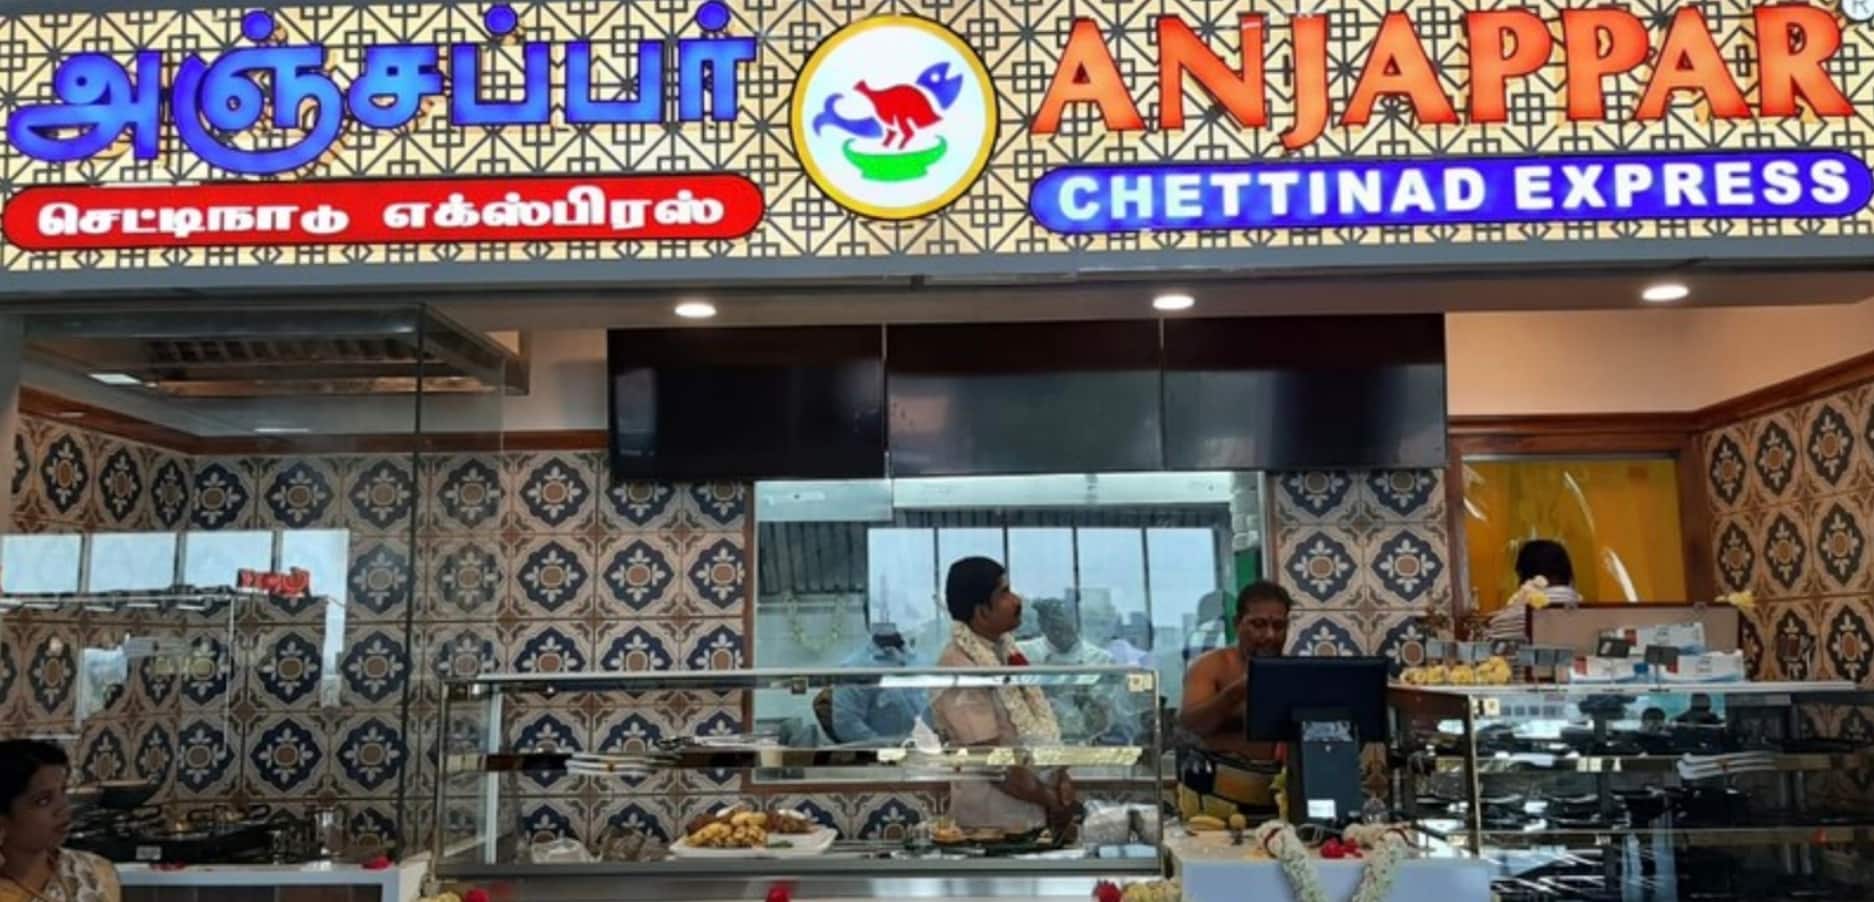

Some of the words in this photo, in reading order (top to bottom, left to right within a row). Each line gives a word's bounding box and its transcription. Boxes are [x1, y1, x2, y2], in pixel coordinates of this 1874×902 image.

[6, 1, 757, 175] அஞ்சப்பர்
[1030, 4, 1856, 150] ANJAPPAR
[37, 202, 350, 238] செட்டிநாடு
[382, 184, 725, 230] எக்ஸ்பிரஸ்
[1058, 167, 1487, 220] CHETTINAD
[1513, 159, 1851, 210] EXPRESS
